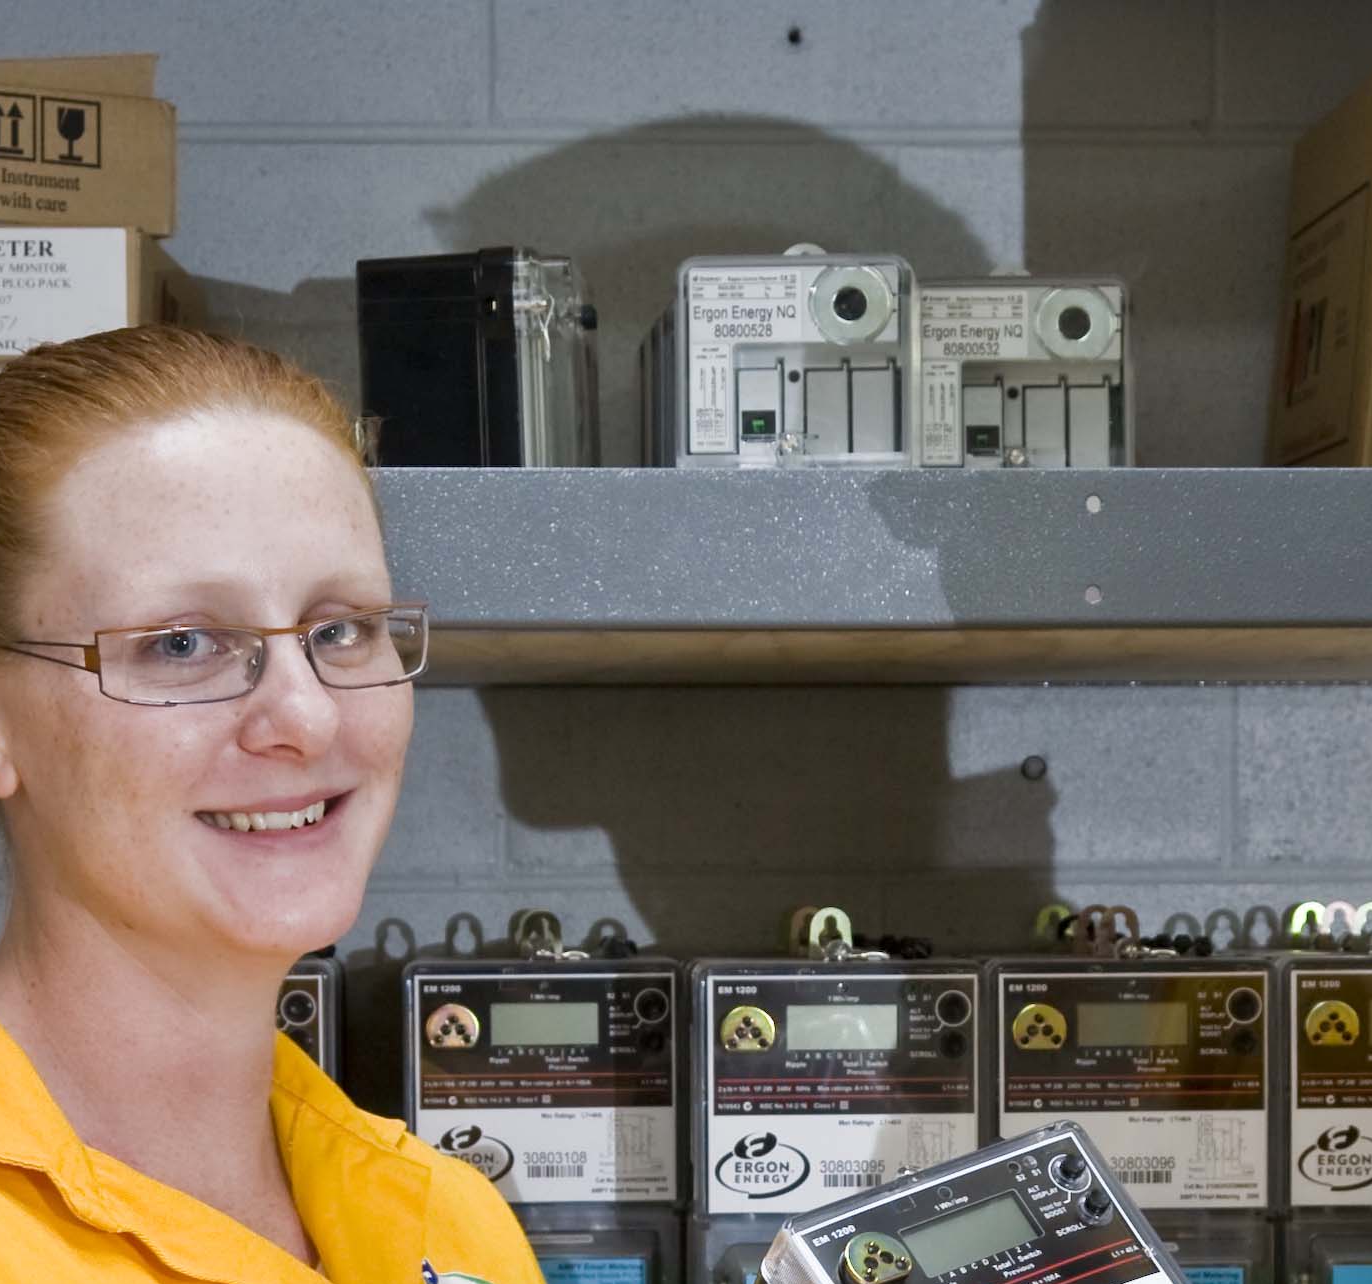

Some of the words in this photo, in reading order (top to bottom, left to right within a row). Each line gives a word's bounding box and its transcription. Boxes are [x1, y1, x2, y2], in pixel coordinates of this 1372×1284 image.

[1, 166, 80, 191] Instrument
[0, 190, 32, 210] with
[35, 196, 68, 213] care
[8, 263, 67, 273] MONITOR
[2, 278, 35, 289] PLUG
[37, 278, 71, 289] PACK
[693, 306, 728, 322] Ergon
[731, 306, 773, 323] Energy
[776, 306, 797, 319] NQ
[714, 324, 773, 337] 80800528
[923, 325, 957, 341] Ergon
[960, 325, 1000, 341] Energy
[1004, 325, 1023, 338] NQ
[943, 342, 1000, 356] 80800532
[423, 985, 438, 993] EM
[441, 985, 461, 993] 1200
[718, 986, 733, 994] EM
[736, 986, 757, 994] 1200
[1008, 984, 1023, 992] EM
[1026, 984, 1048, 992] 1200
[1301, 980, 1316, 988] EM
[1319, 980, 1340, 988] 1200
[523, 1151, 587, 1164] 30803108
[1110, 1157, 1176, 1169] 30803096
[1318, 1154, 1372, 1165] ERGON
[734, 1161, 790, 1173] ERGON
[820, 1160, 885, 1173] 30803095
[1318, 1167, 1372, 1176] ENERGY
[734, 1174, 789, 1184] ENERGY
[1027, 1185, 1039, 1194] ALT
[1031, 1187, 1059, 1201] DISPLAY
[1044, 1207, 1067, 1220] BOOST
[812, 1235, 830, 1248] EM
[830, 1224, 856, 1241] 1200
[1055, 1222, 1087, 1237] SCROLL
[992, 1260, 1012, 1272] Total
[1017, 1249, 1043, 1263] Switch
[1003, 1263, 1036, 1279] Previous
